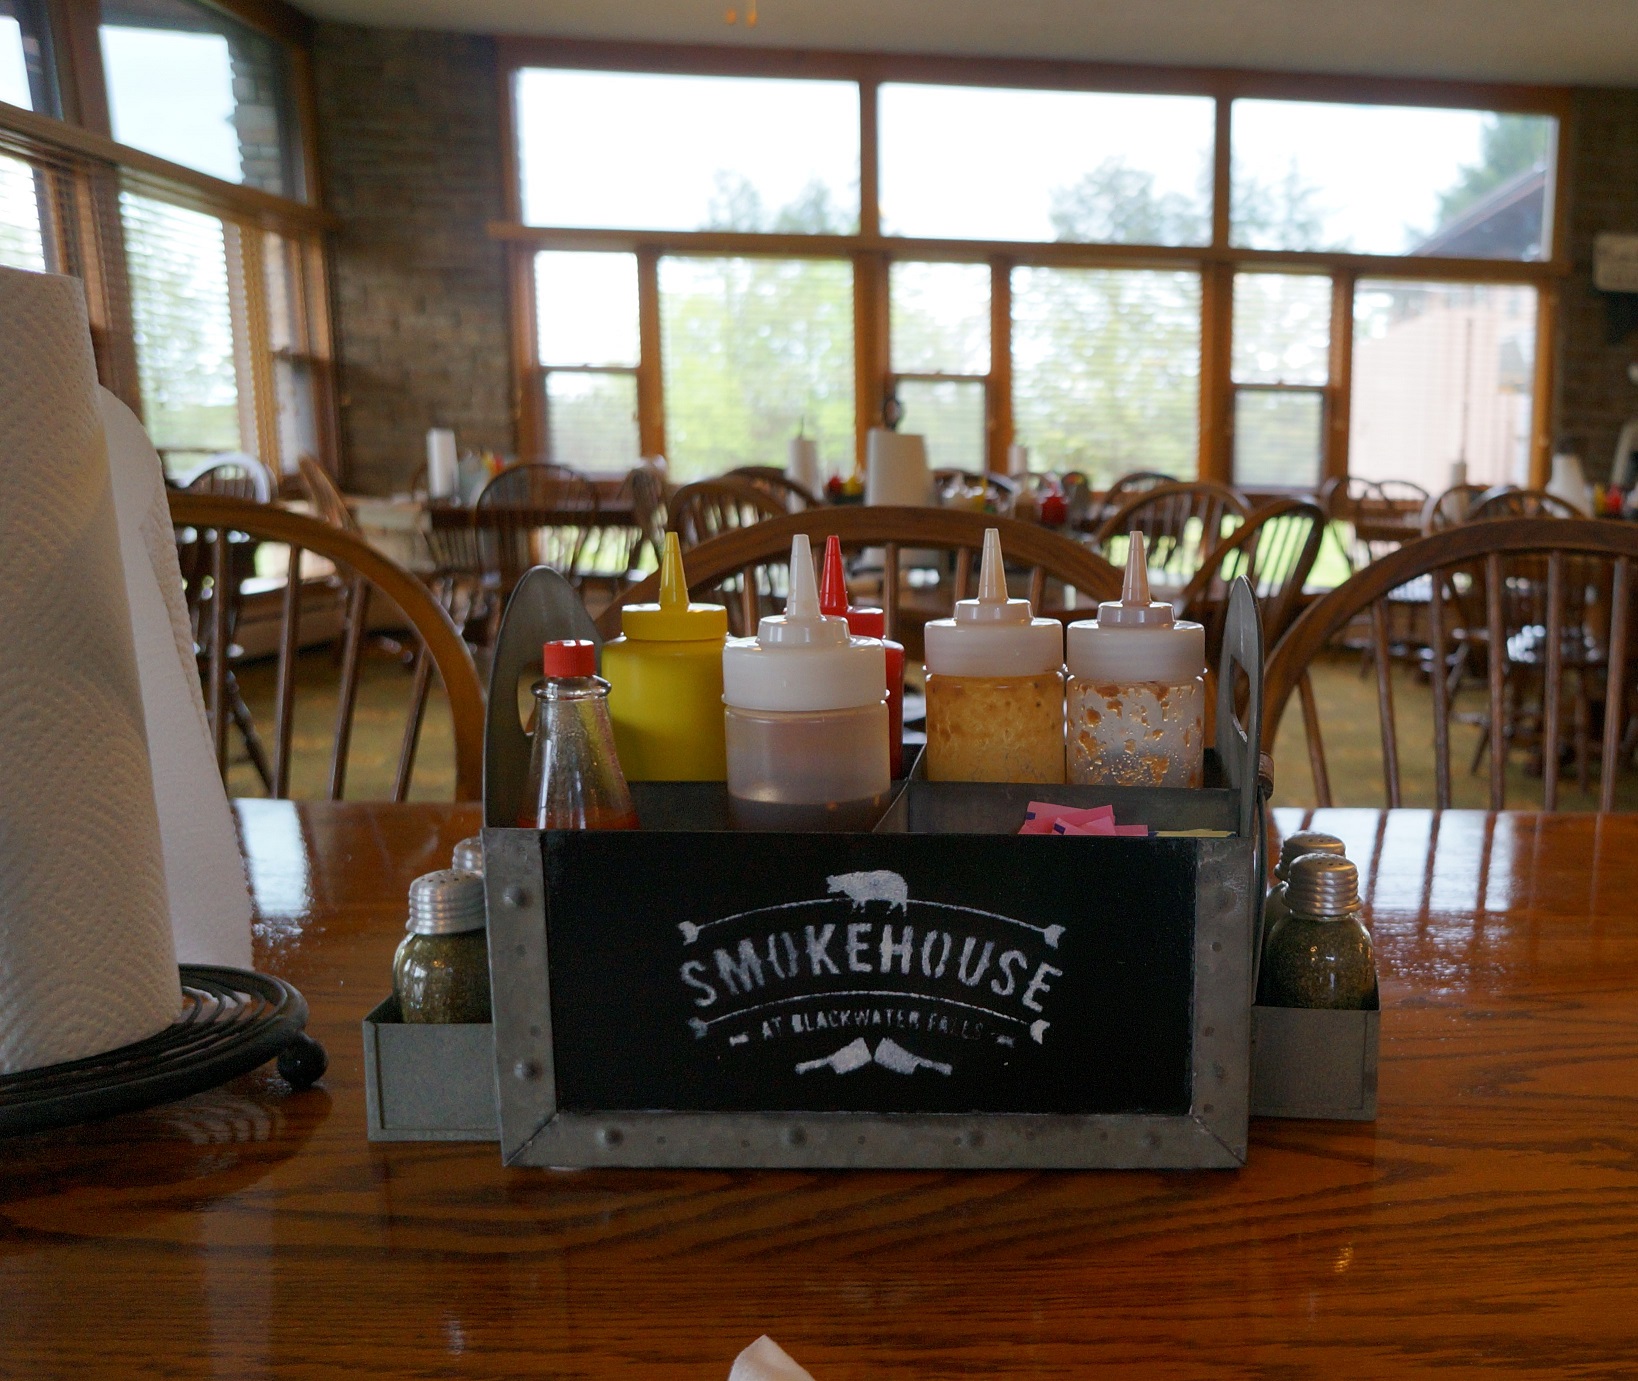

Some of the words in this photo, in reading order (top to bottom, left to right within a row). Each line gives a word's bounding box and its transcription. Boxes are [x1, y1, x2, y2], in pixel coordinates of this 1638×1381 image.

[679, 922, 1064, 1012] SMOKEHOUSE
[761, 1015, 783, 1041] AT
[791, 1008, 920, 1034] BLACKWATER
[926, 1012, 984, 1040] FALS
